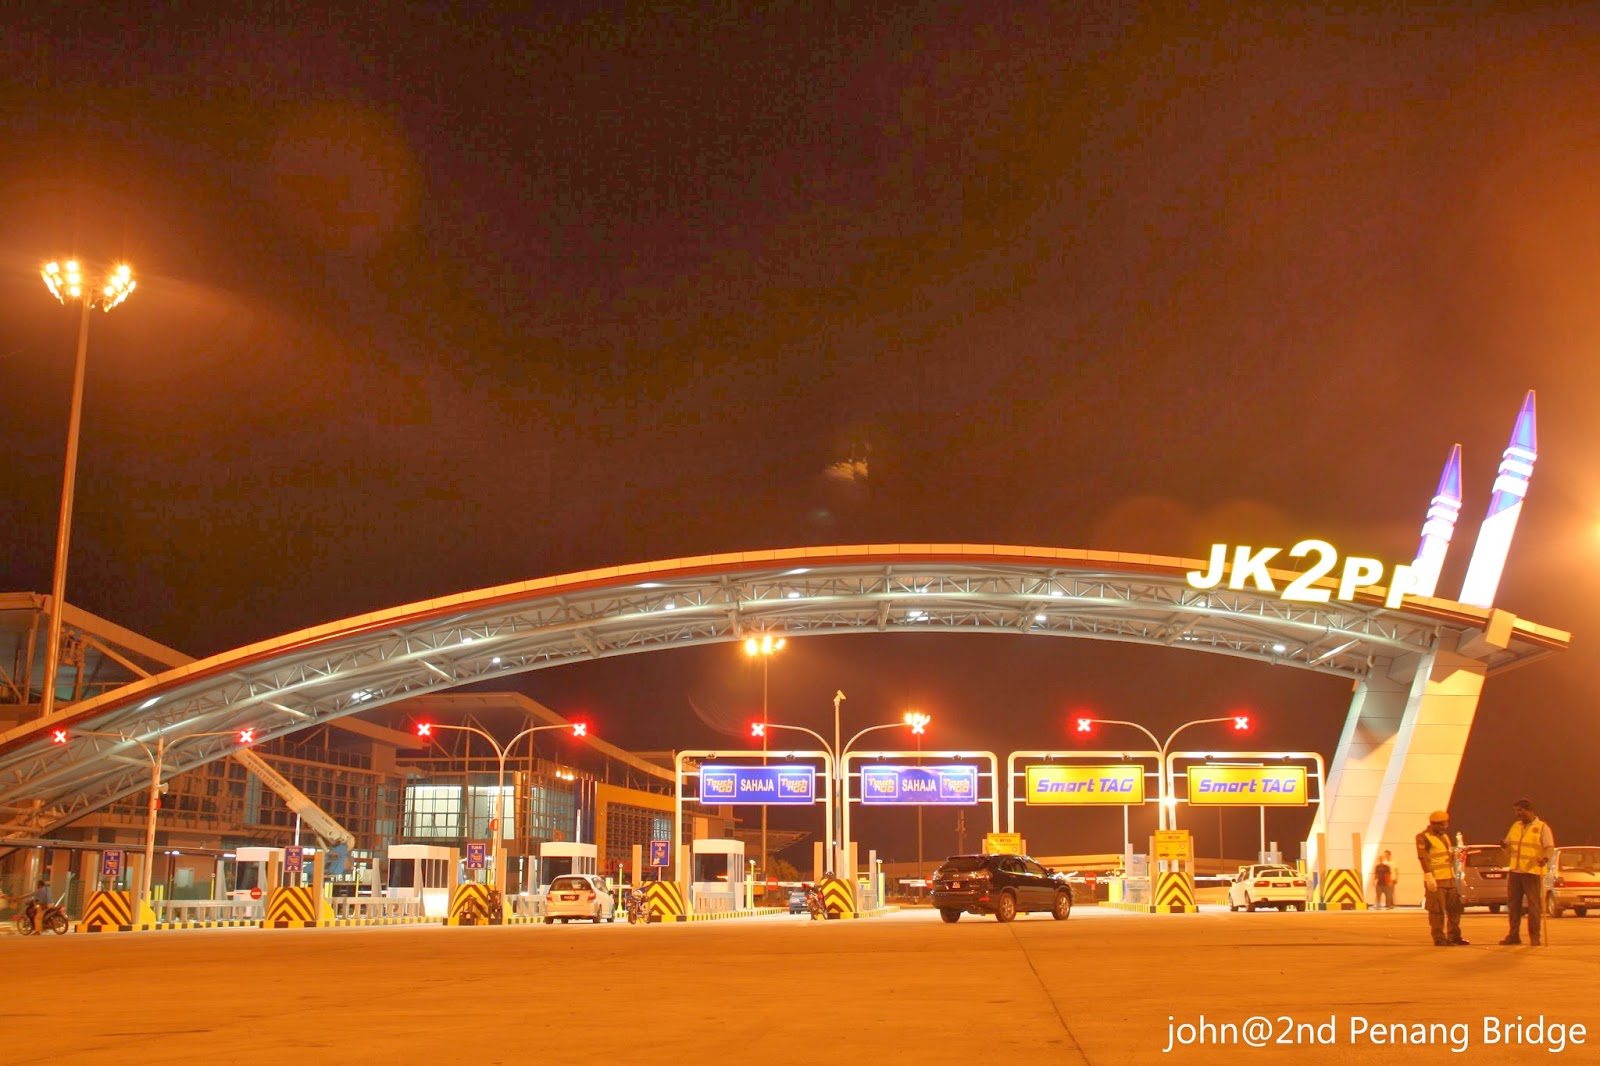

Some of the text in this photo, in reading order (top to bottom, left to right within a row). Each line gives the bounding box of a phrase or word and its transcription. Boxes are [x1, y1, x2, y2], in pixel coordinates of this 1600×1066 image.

[706, 778, 733, 786] Touch
[740, 779, 774, 791] SAHAJA
[781, 778, 808, 786] Touch
[902, 779, 936, 791] SAHAJA
[1036, 779, 1134, 792] Smart TAG
[1199, 779, 1296, 792] Smart TAG
